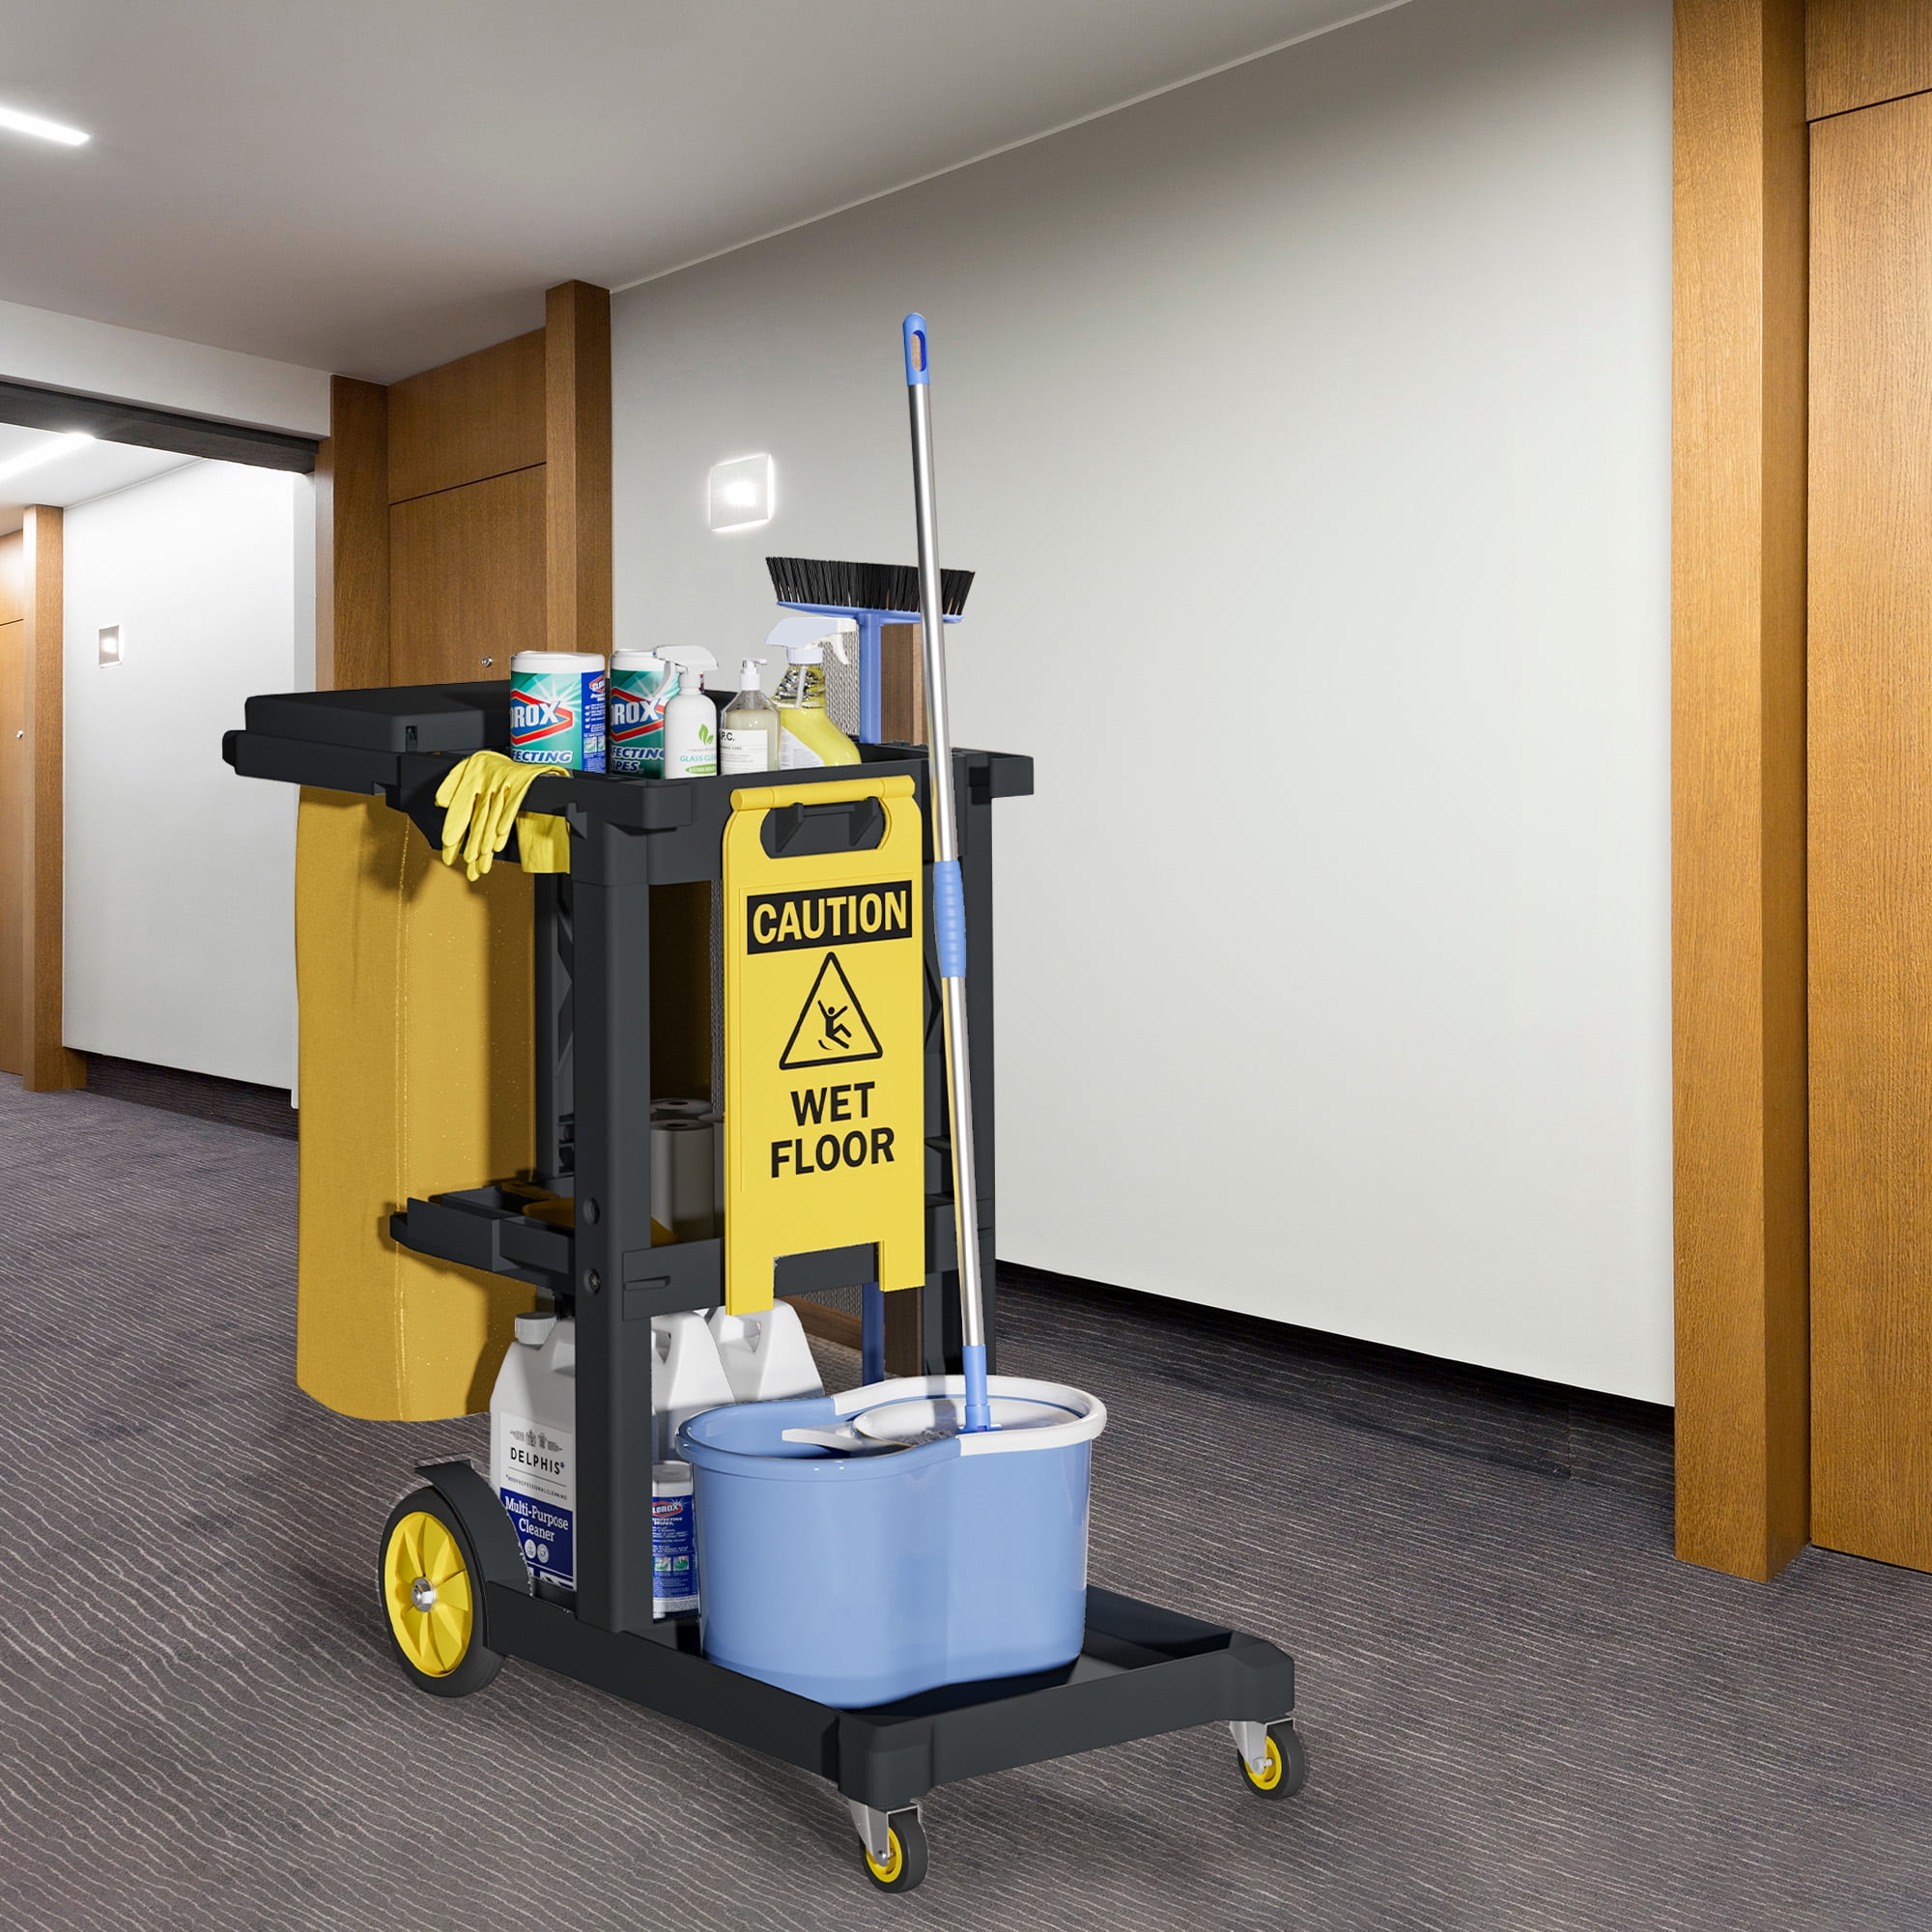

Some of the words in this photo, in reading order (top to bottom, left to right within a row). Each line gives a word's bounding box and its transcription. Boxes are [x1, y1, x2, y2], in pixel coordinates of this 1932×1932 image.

[753, 890, 907, 945] CAUTION
[790, 1081, 876, 1127] WET
[771, 1127, 895, 1179] FLOOR
[510, 1447, 560, 1475] DELPHIS
[504, 1495, 569, 1531] Multi-Purpose
[518, 1518, 556, 1543] Cleaner
